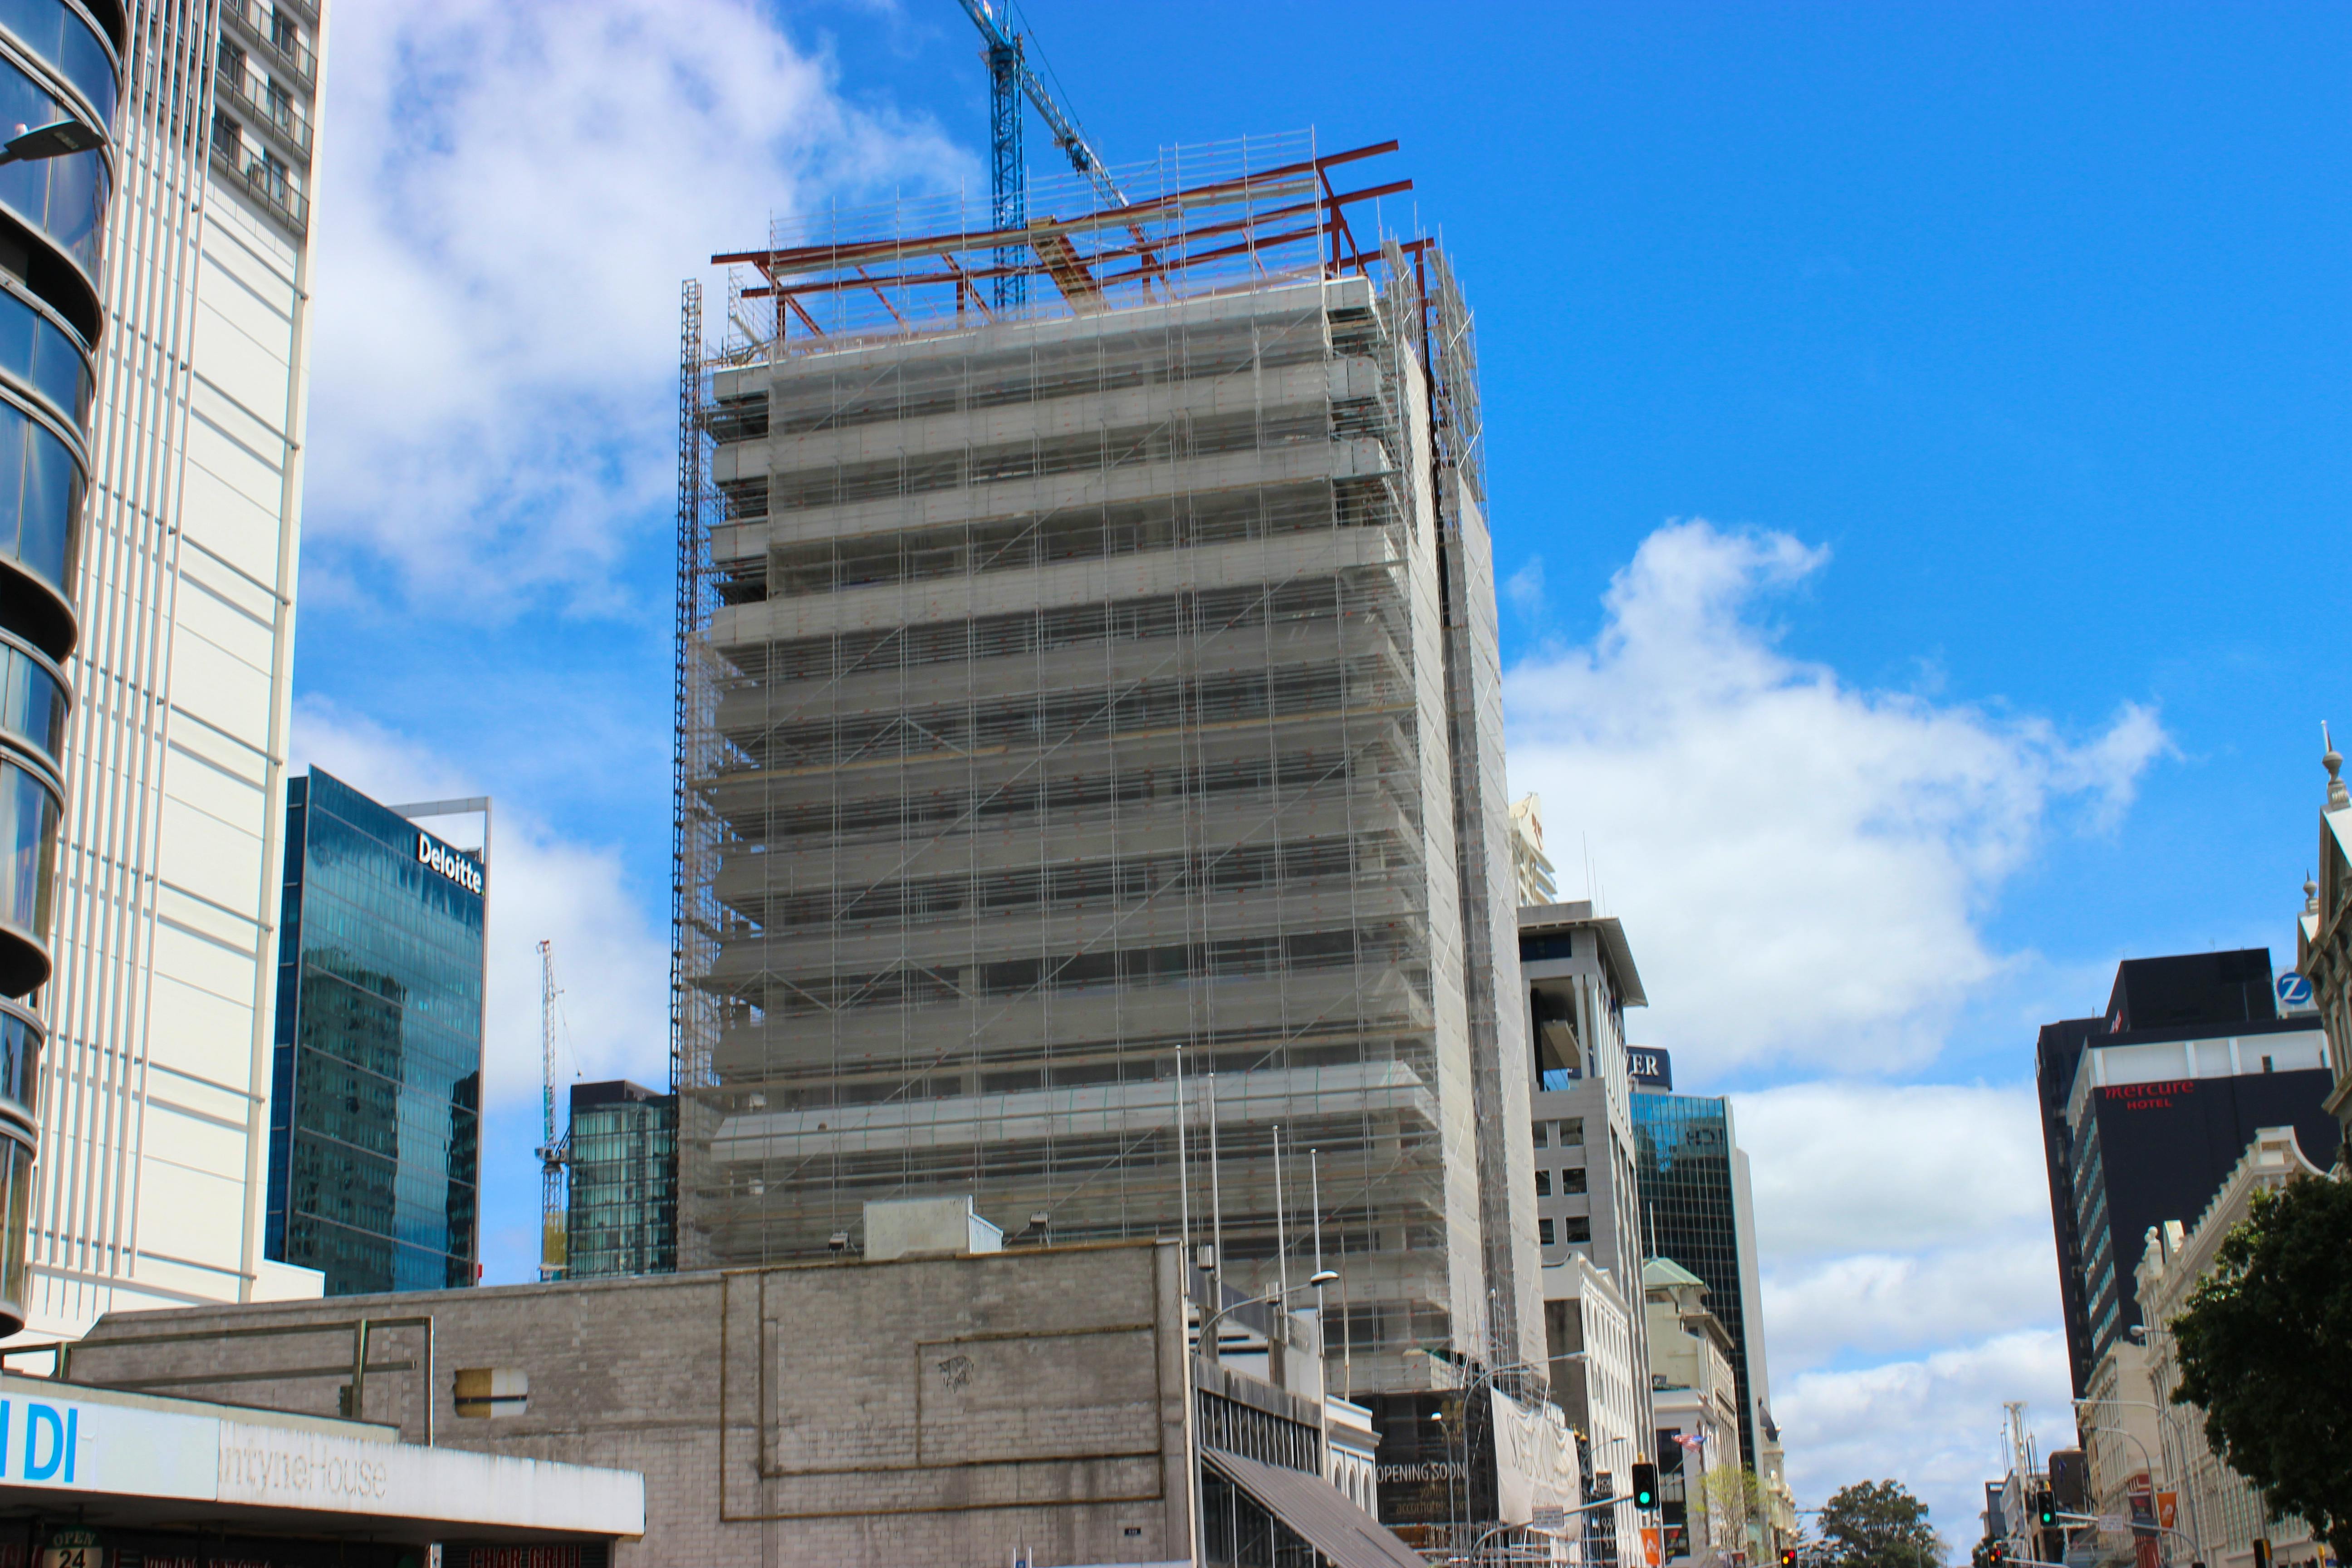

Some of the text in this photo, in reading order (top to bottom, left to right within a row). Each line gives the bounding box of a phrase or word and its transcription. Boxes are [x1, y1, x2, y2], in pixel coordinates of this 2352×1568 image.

[2127, 1098, 2173, 1111] HOTEL
[1376, 1461, 1466, 1484] OPENING SOON
[53, 1530, 96, 1547] OPEN
[60, 1548, 86, 1568] 24
